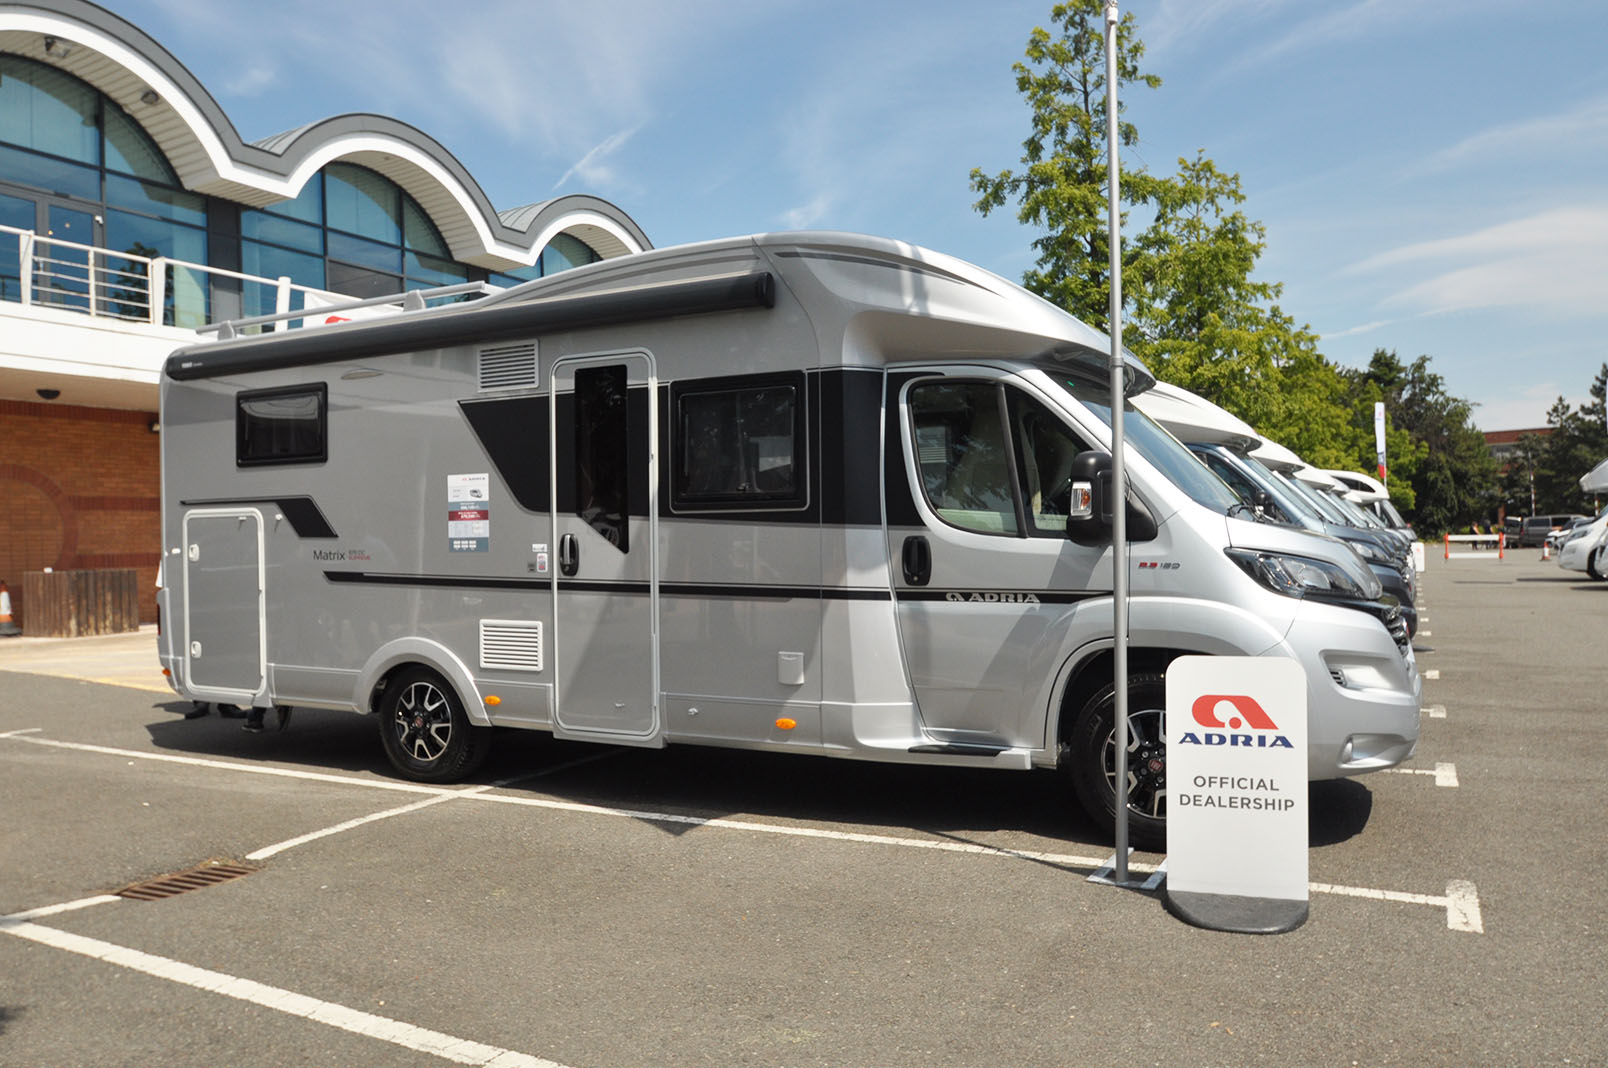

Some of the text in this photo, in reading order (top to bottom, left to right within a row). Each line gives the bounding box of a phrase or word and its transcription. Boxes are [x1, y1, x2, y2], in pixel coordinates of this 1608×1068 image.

[313, 550, 345, 561] Matrix
[969, 592, 1040, 603] ADRIA
[1178, 732, 1294, 749] ADRIA
[1193, 775, 1280, 791] OFFICIAL
[1179, 794, 1295, 812] DEALERSHIP
